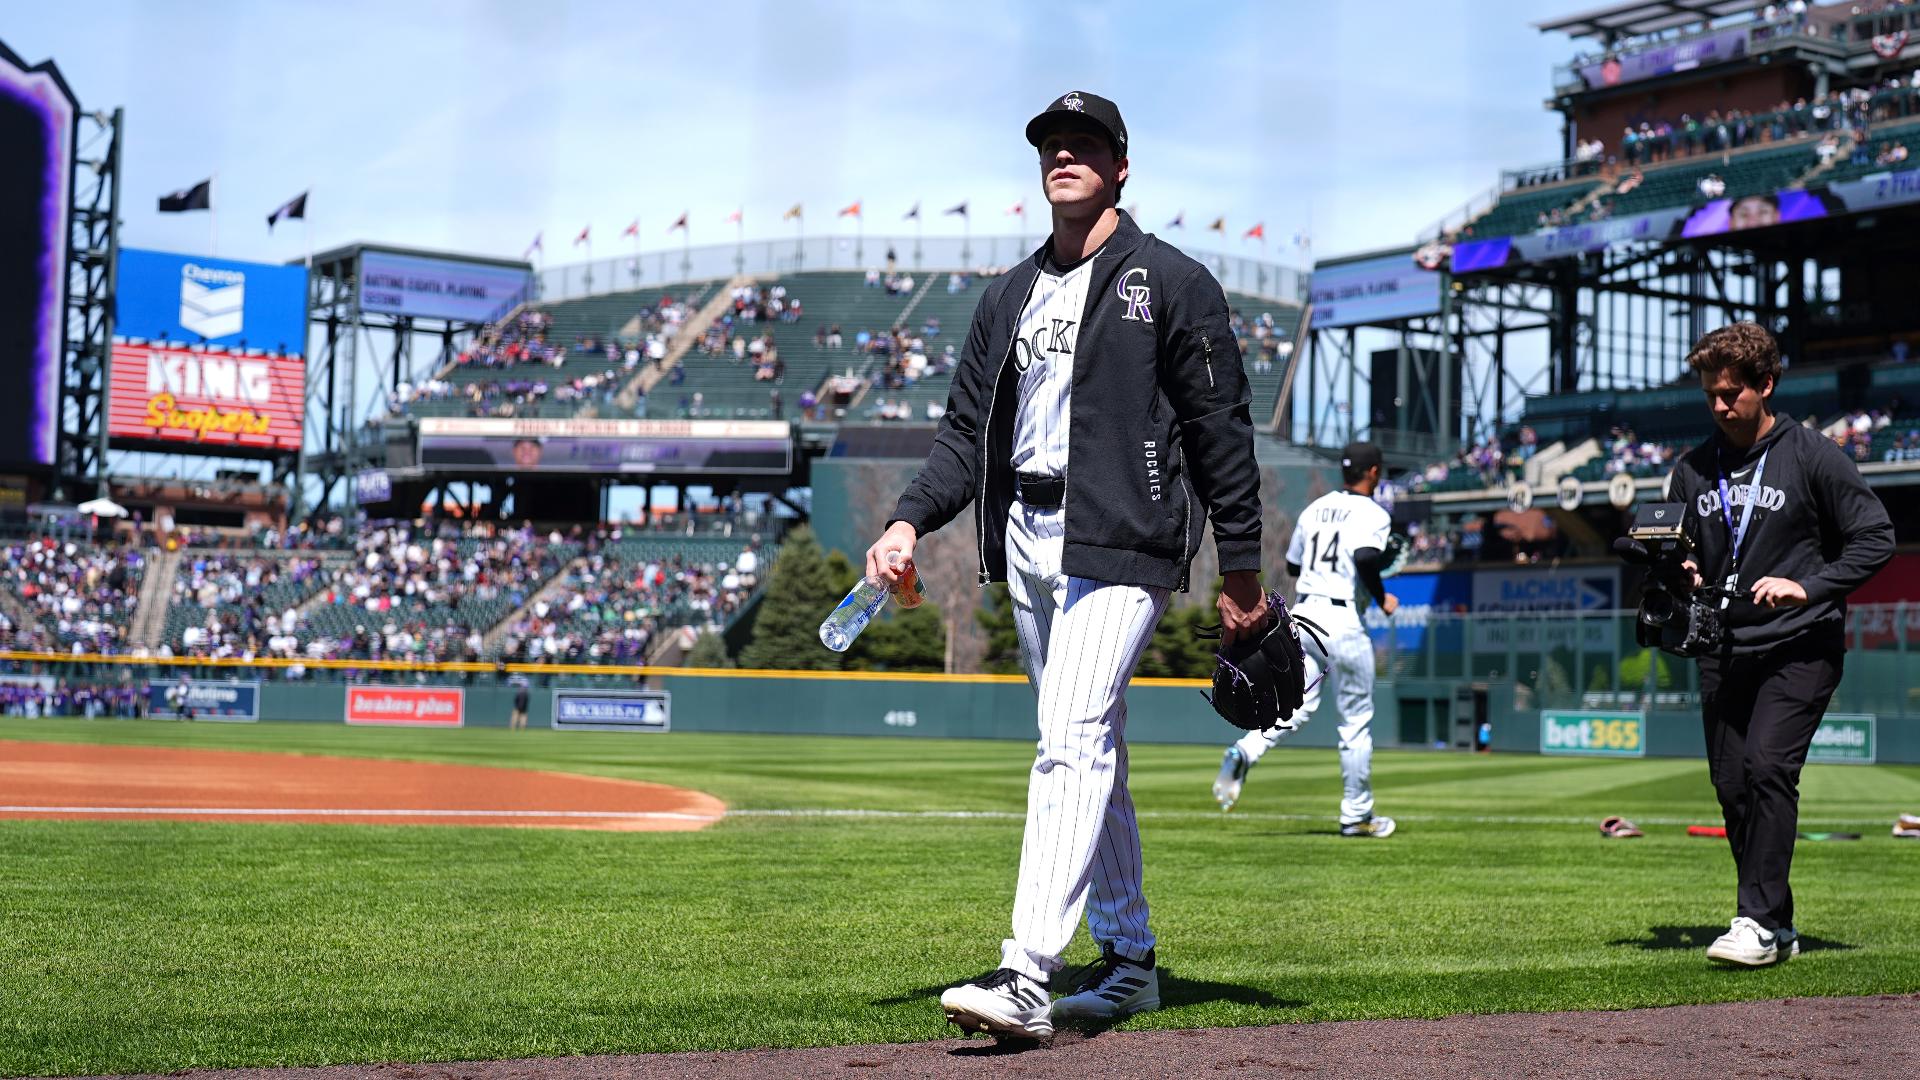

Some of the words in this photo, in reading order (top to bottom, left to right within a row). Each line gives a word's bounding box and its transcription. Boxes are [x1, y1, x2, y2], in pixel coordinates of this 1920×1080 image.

[181, 263, 246, 285] Chevron
[1117, 267, 1154, 323] CR
[147, 354, 272, 403] KING
[144, 392, 271, 440] Soopers
[1144, 441, 1161, 501] ROCKIES
[1697, 484, 1786, 518] COORDO
[1309, 531, 1340, 573] 14
[1502, 579, 1578, 601] BACHUS
[354, 694, 414, 714] brakes
[416, 697, 455, 718] plus
[883, 709, 917, 727] 415
[1546, 718, 1640, 750] bet365
